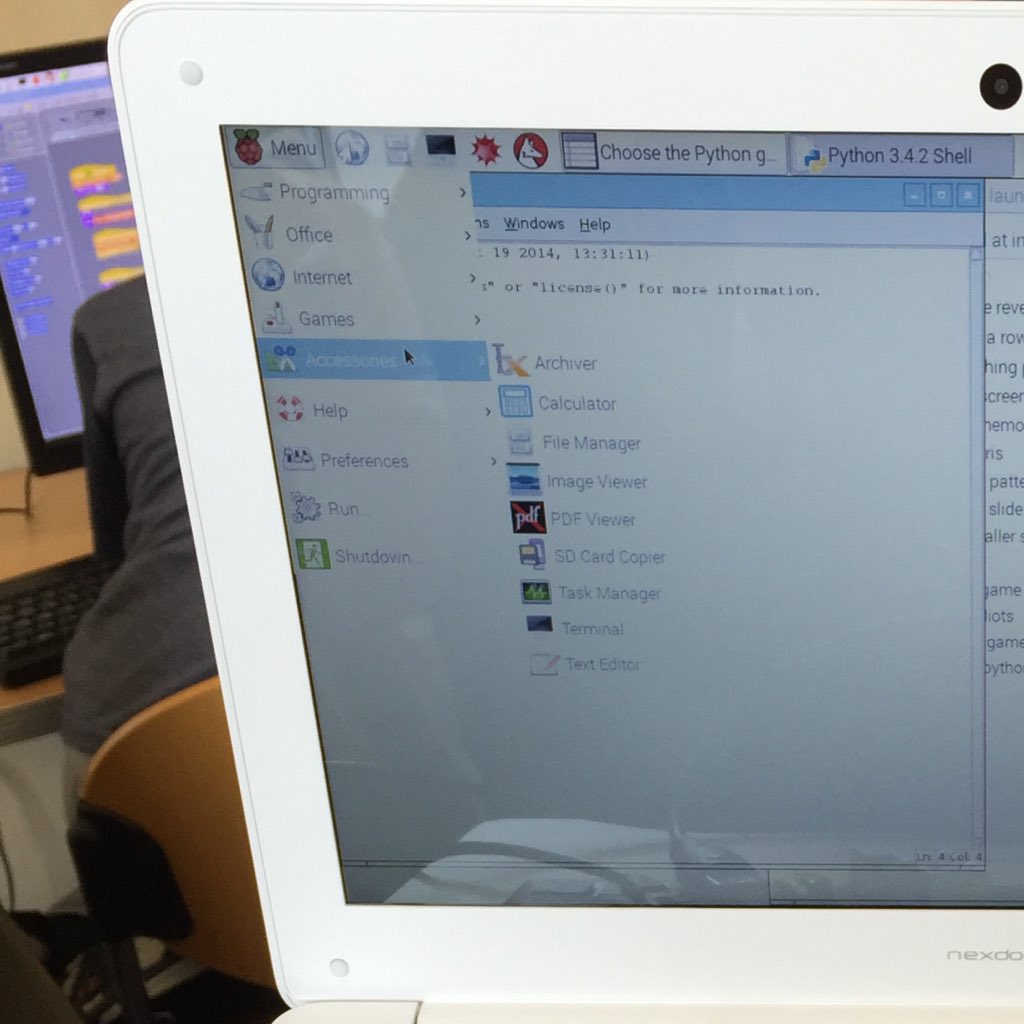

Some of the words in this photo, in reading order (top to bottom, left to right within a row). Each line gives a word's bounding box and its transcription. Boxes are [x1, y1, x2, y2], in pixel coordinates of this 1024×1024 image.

[271, 140, 317, 158] Menu
[600, 144, 659, 161] Choose
[665, 144, 690, 161] the
[695, 145, 752, 167] Python
[828, 147, 885, 167] Python
[889, 148, 930, 164] 3.4.2
[933, 148, 972, 165] Shell
[279, 184, 390, 204] Programming
[503, 217, 565, 232] Windows
[580, 218, 611, 234] Help
[286, 227, 333, 243] Office
[992, 233, 1008, 249] at
[494, 247, 510, 258] 19
[519, 247, 561, 260] 2014,
[293, 270, 352, 286] Internet
[505, 283, 522, 292] or
[638, 283, 665, 295] for
[672, 286, 708, 296] more
[717, 284, 821, 297] information.
[300, 311, 355, 328] Games
[535, 356, 598, 371] Archiver
[313, 403, 348, 421] Help
[539, 396, 617, 412] Calculator
[543, 435, 569, 450] File
[572, 436, 641, 454] Manager
[321, 452, 409, 469] Preferences
[546, 475, 595, 492] Image
[598, 475, 648, 489] Viewer
[988, 502, 1024, 517] slide
[551, 512, 582, 527] PDF
[586, 512, 636, 527] Viewer
[554, 550, 575, 564] SD
[580, 550, 615, 564] Card
[619, 550, 666, 566] Copier
[559, 586, 592, 600] Task
[597, 587, 662, 604] Manager
[562, 622, 624, 636] Terminal
[566, 657, 595, 671] Text
[600, 657, 641, 671] Editor
